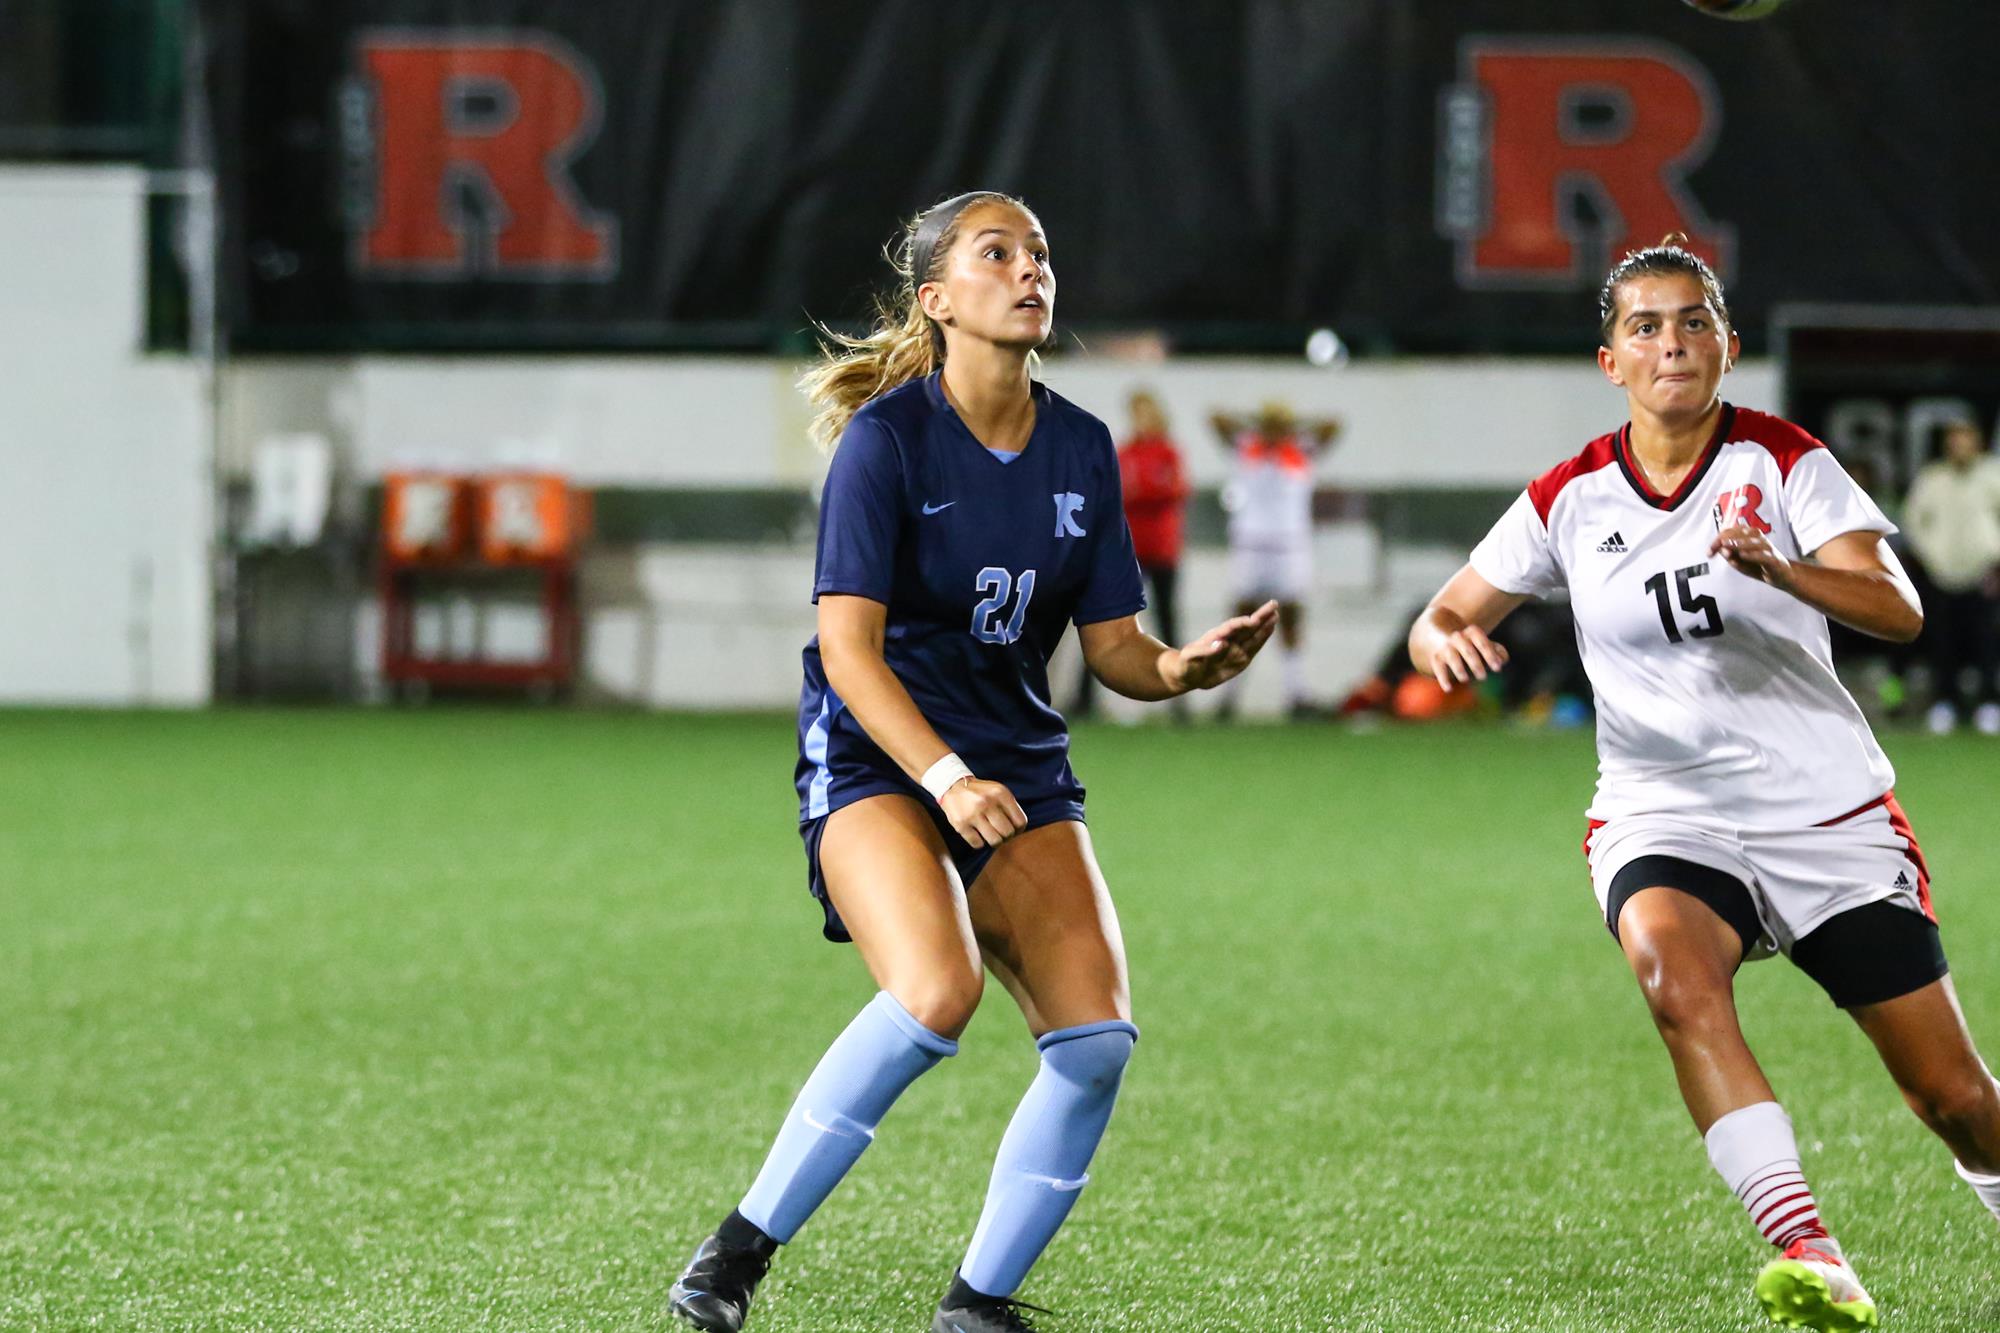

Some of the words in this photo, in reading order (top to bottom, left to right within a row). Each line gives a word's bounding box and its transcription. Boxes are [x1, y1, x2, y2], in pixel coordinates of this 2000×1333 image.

[361, 35, 616, 276] R
[1460, 40, 1733, 284] R
[1717, 483, 1772, 535] R
[970, 566, 1037, 646] 21
[1644, 562, 1725, 644] 15
